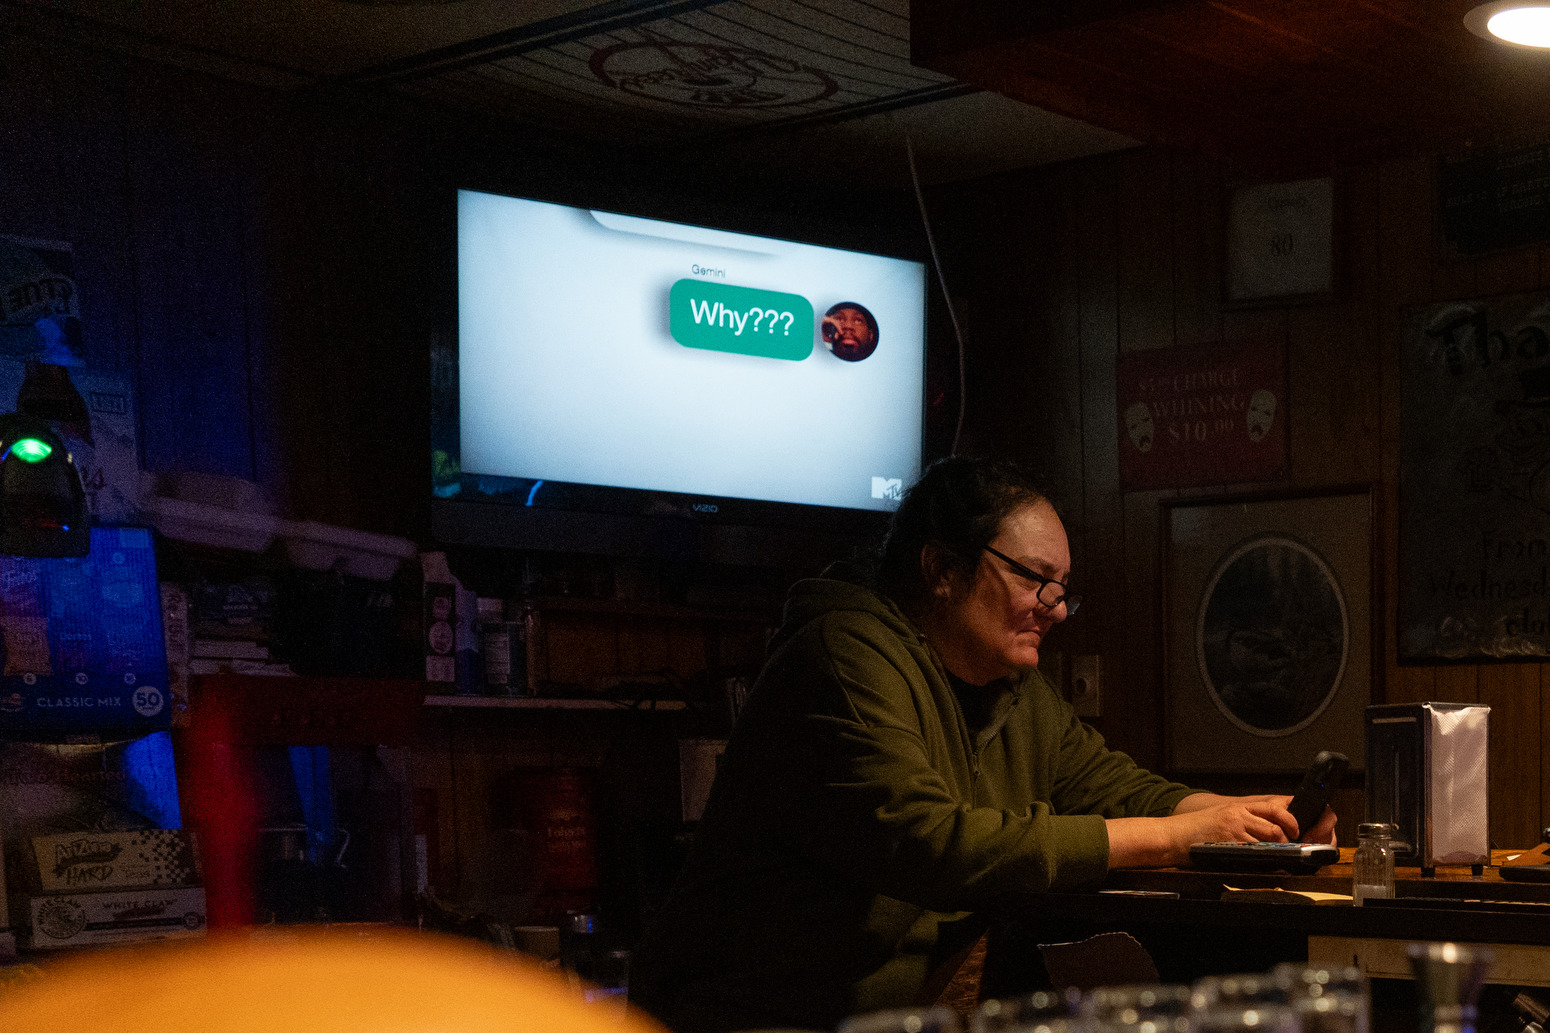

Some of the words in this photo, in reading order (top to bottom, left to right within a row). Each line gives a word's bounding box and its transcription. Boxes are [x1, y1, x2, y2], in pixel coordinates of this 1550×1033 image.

[691, 264, 726, 279] Gemini
[689, 297, 795, 336] Why???
[871, 476, 904, 502] MTV
[692, 503, 719, 514] VIZIO
[1481, 530, 1547, 559] From
[37, 697, 94, 708] CLASSIC
[97, 696, 122, 707] MIX
[136, 692, 160, 707] 50
[67, 865, 114, 886] HARD
[103, 901, 139, 910] WHITE
[144, 899, 173, 908] CLAW
